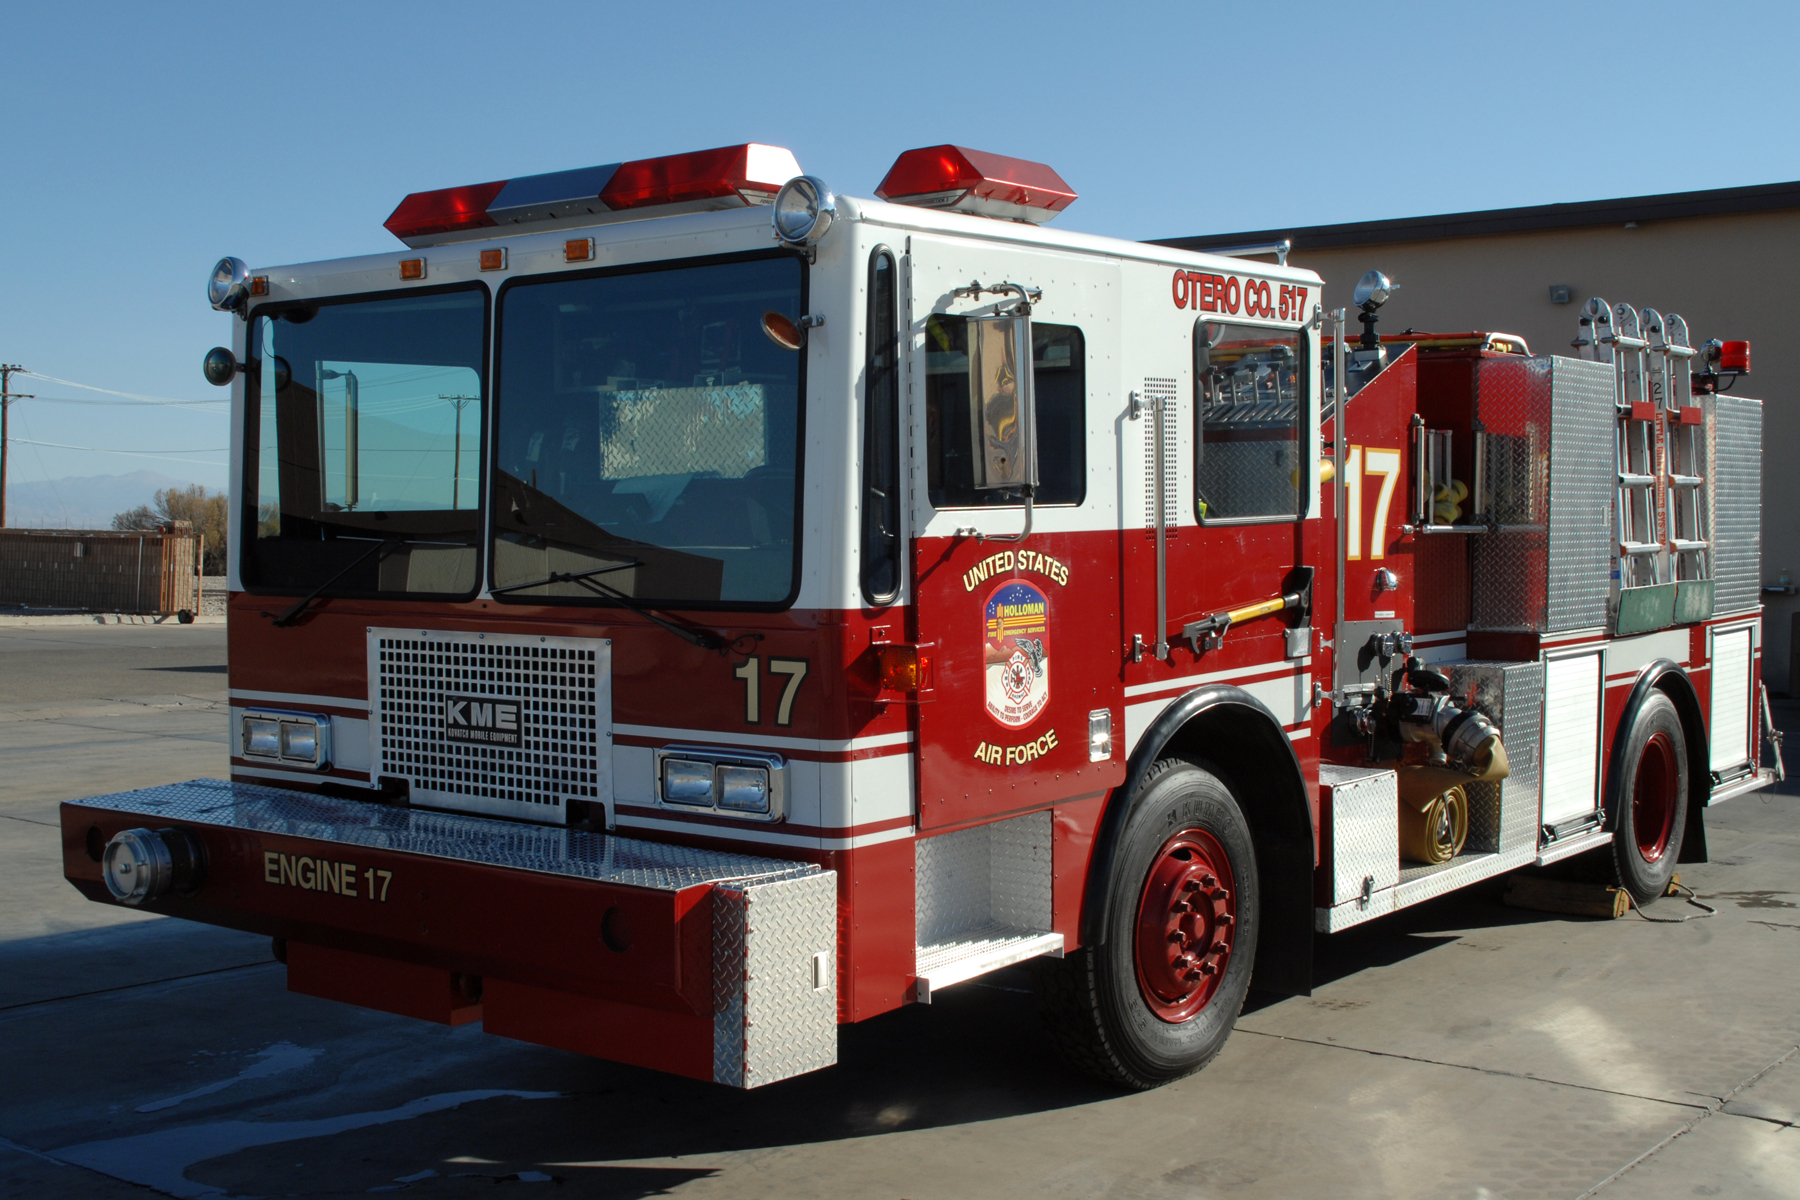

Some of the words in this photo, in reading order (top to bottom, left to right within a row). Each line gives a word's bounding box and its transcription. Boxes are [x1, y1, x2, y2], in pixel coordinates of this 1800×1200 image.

[1172, 268, 1241, 315] OTERO
[1244, 278, 1276, 319] CO.
[1278, 284, 1308, 322] 517
[1656, 412, 1664, 444] LITTLE
[1344, 444, 1401, 560] 17
[1656, 476, 1666, 509] LADDER
[962, 550, 1015, 592] UNITED
[1017, 549, 1069, 587] STATES
[1003, 602, 1045, 617] HOLLOMAN
[733, 655, 810, 727] 17
[447, 700, 518, 730] KME
[447, 728, 469, 739] KOVATCH
[470, 729, 489, 741] MOBILE
[489, 731, 518, 744] EQUIPMENT
[973, 740, 1002, 766] AIR
[1005, 728, 1059, 767] FORCE
[1181, 799, 1232, 834] KUMHO
[264, 851, 358, 897] ENGINE
[364, 867, 393, 902] 17
